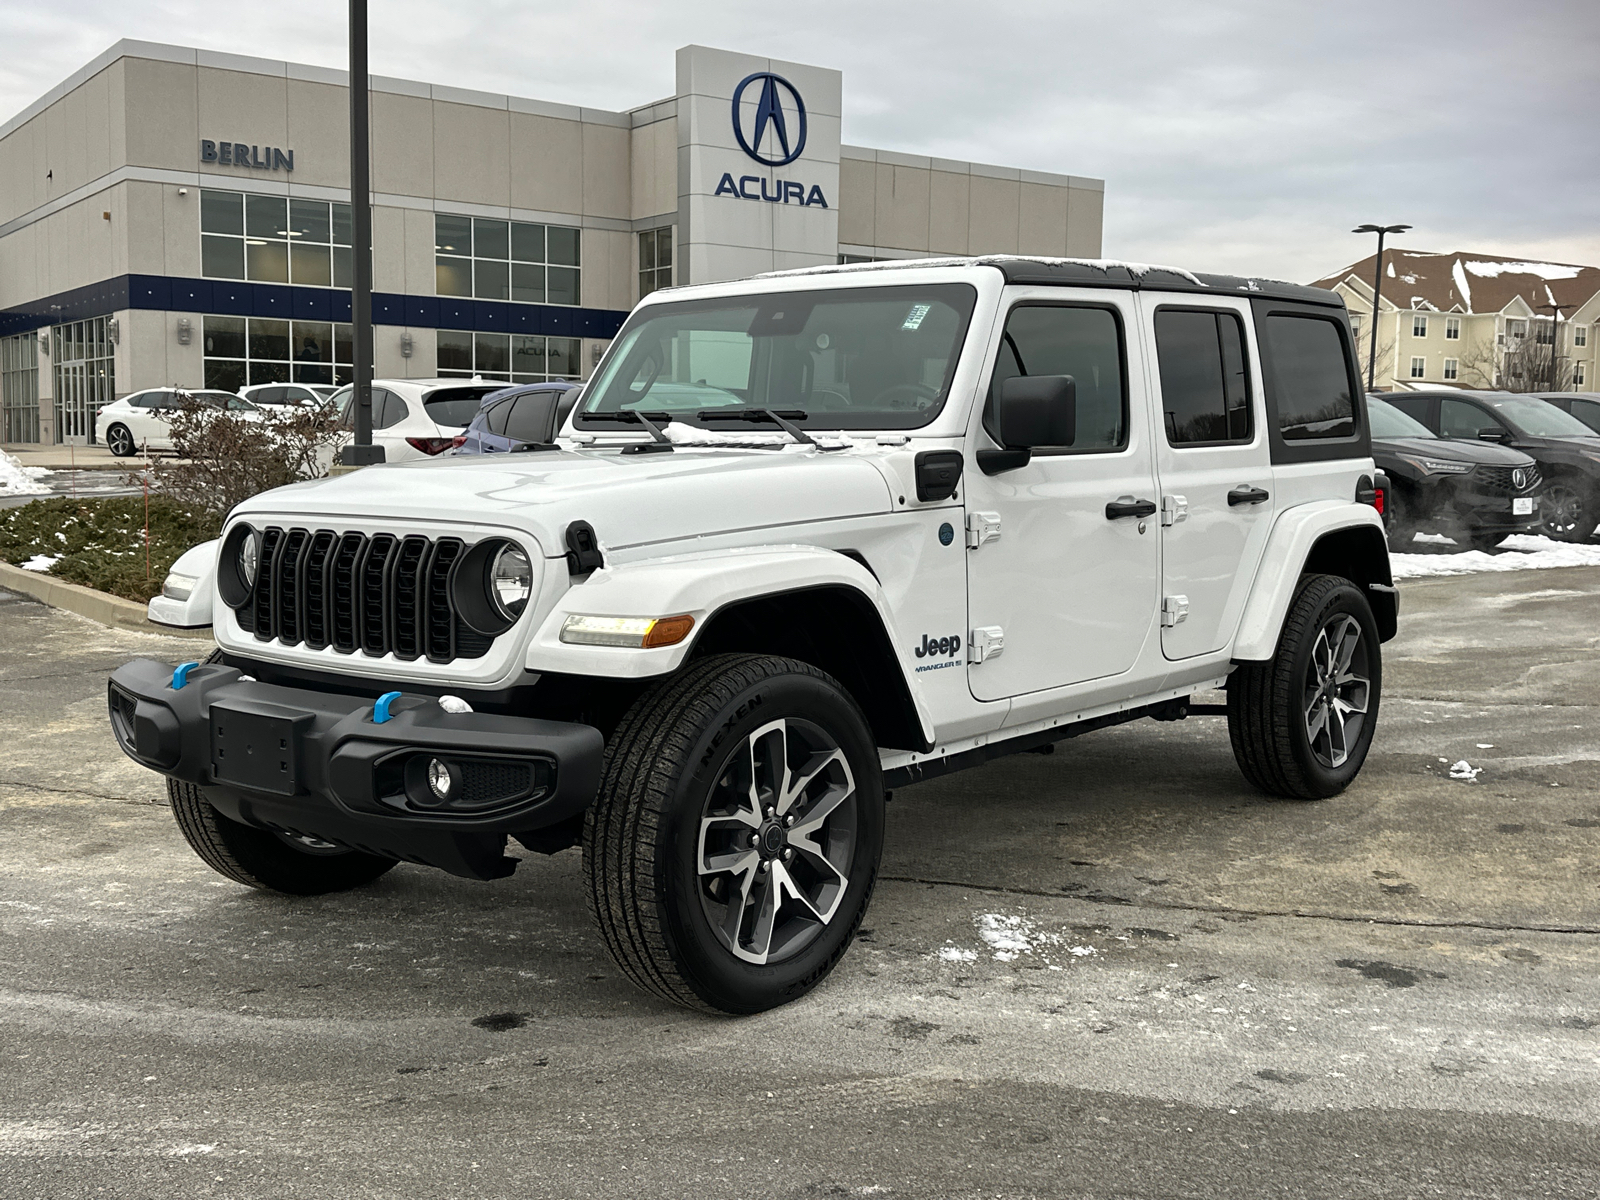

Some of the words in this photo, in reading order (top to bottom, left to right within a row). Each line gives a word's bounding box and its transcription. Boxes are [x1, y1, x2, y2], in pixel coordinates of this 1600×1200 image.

[201, 139, 294, 172] BERLIN
[714, 172, 829, 209] ACURA
[914, 633, 961, 658] Jeep
[914, 661, 955, 673] WRANGLER
[700, 693, 763, 768] NEXEN
